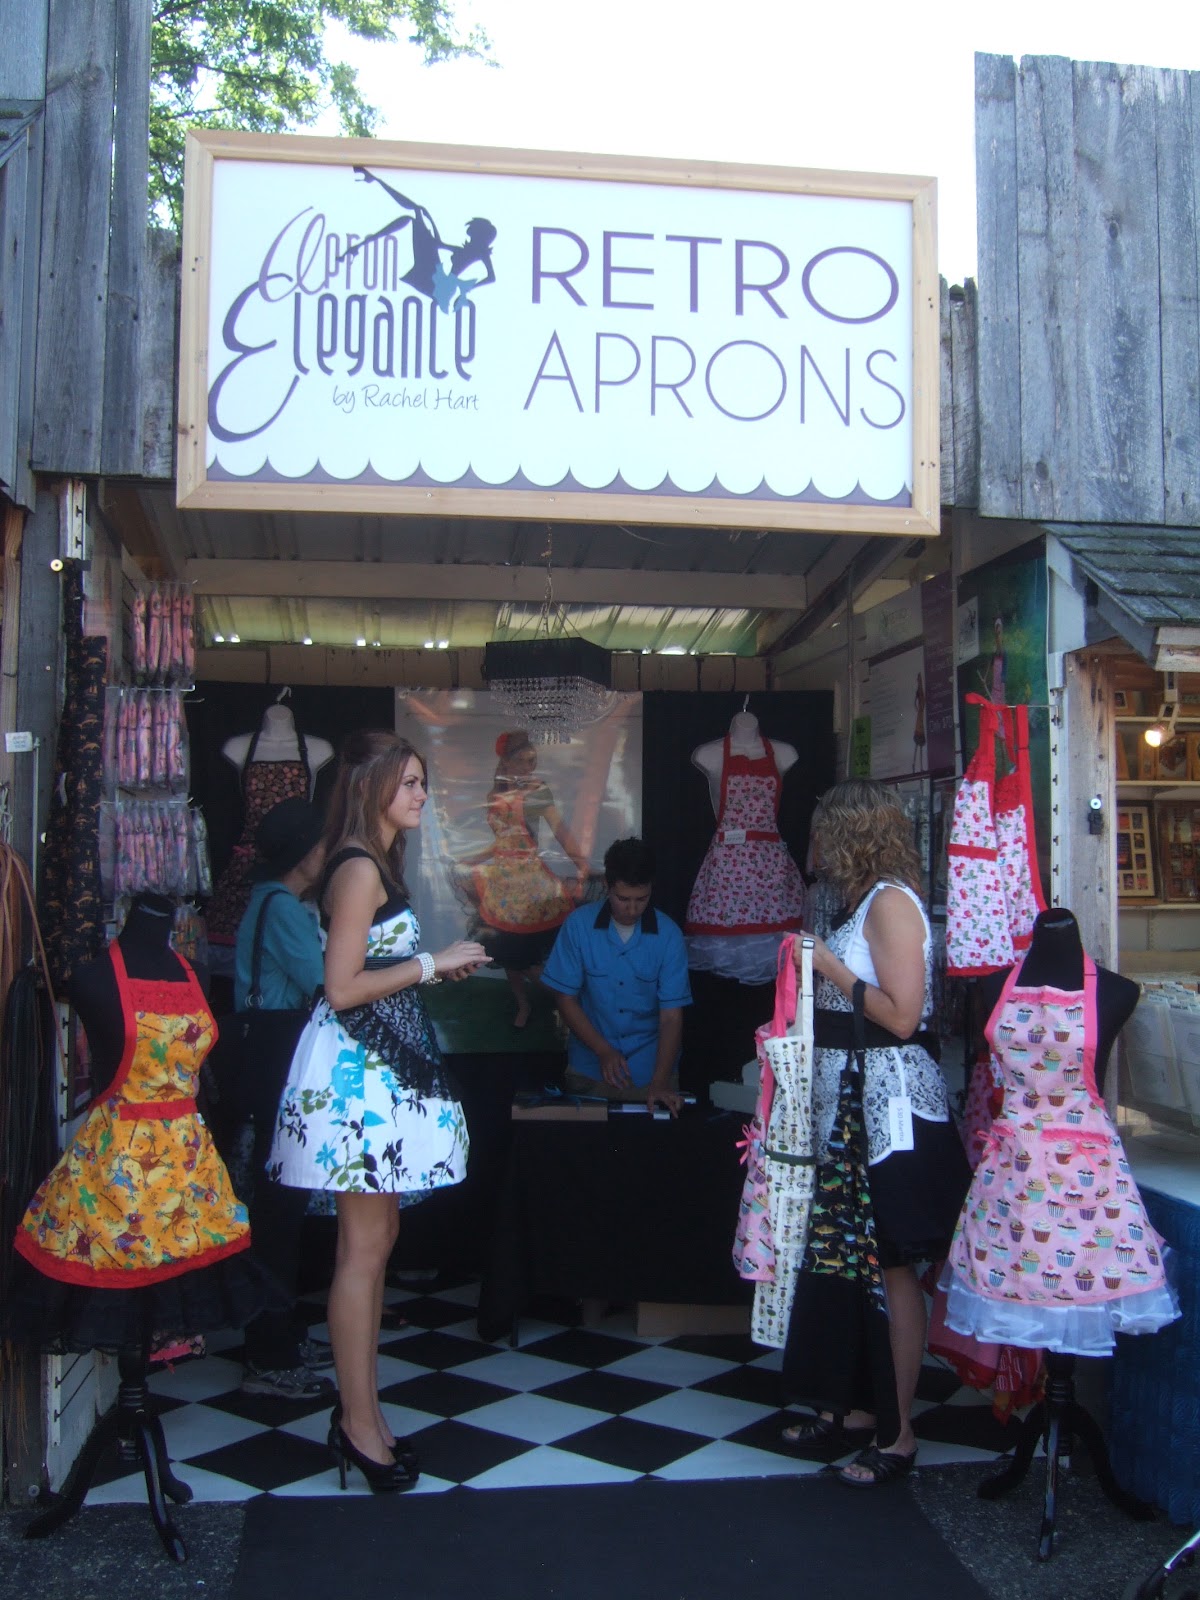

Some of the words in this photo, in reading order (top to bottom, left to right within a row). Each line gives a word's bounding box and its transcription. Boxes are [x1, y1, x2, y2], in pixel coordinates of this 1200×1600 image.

[258, 206, 398, 302] Apron
[532, 226, 899, 324] RETRO
[207, 272, 476, 443] Elegance
[333, 385, 355, 413] by
[361, 384, 428, 408] Rachel
[433, 388, 479, 410] Hart
[523, 329, 906, 430] APRONS
